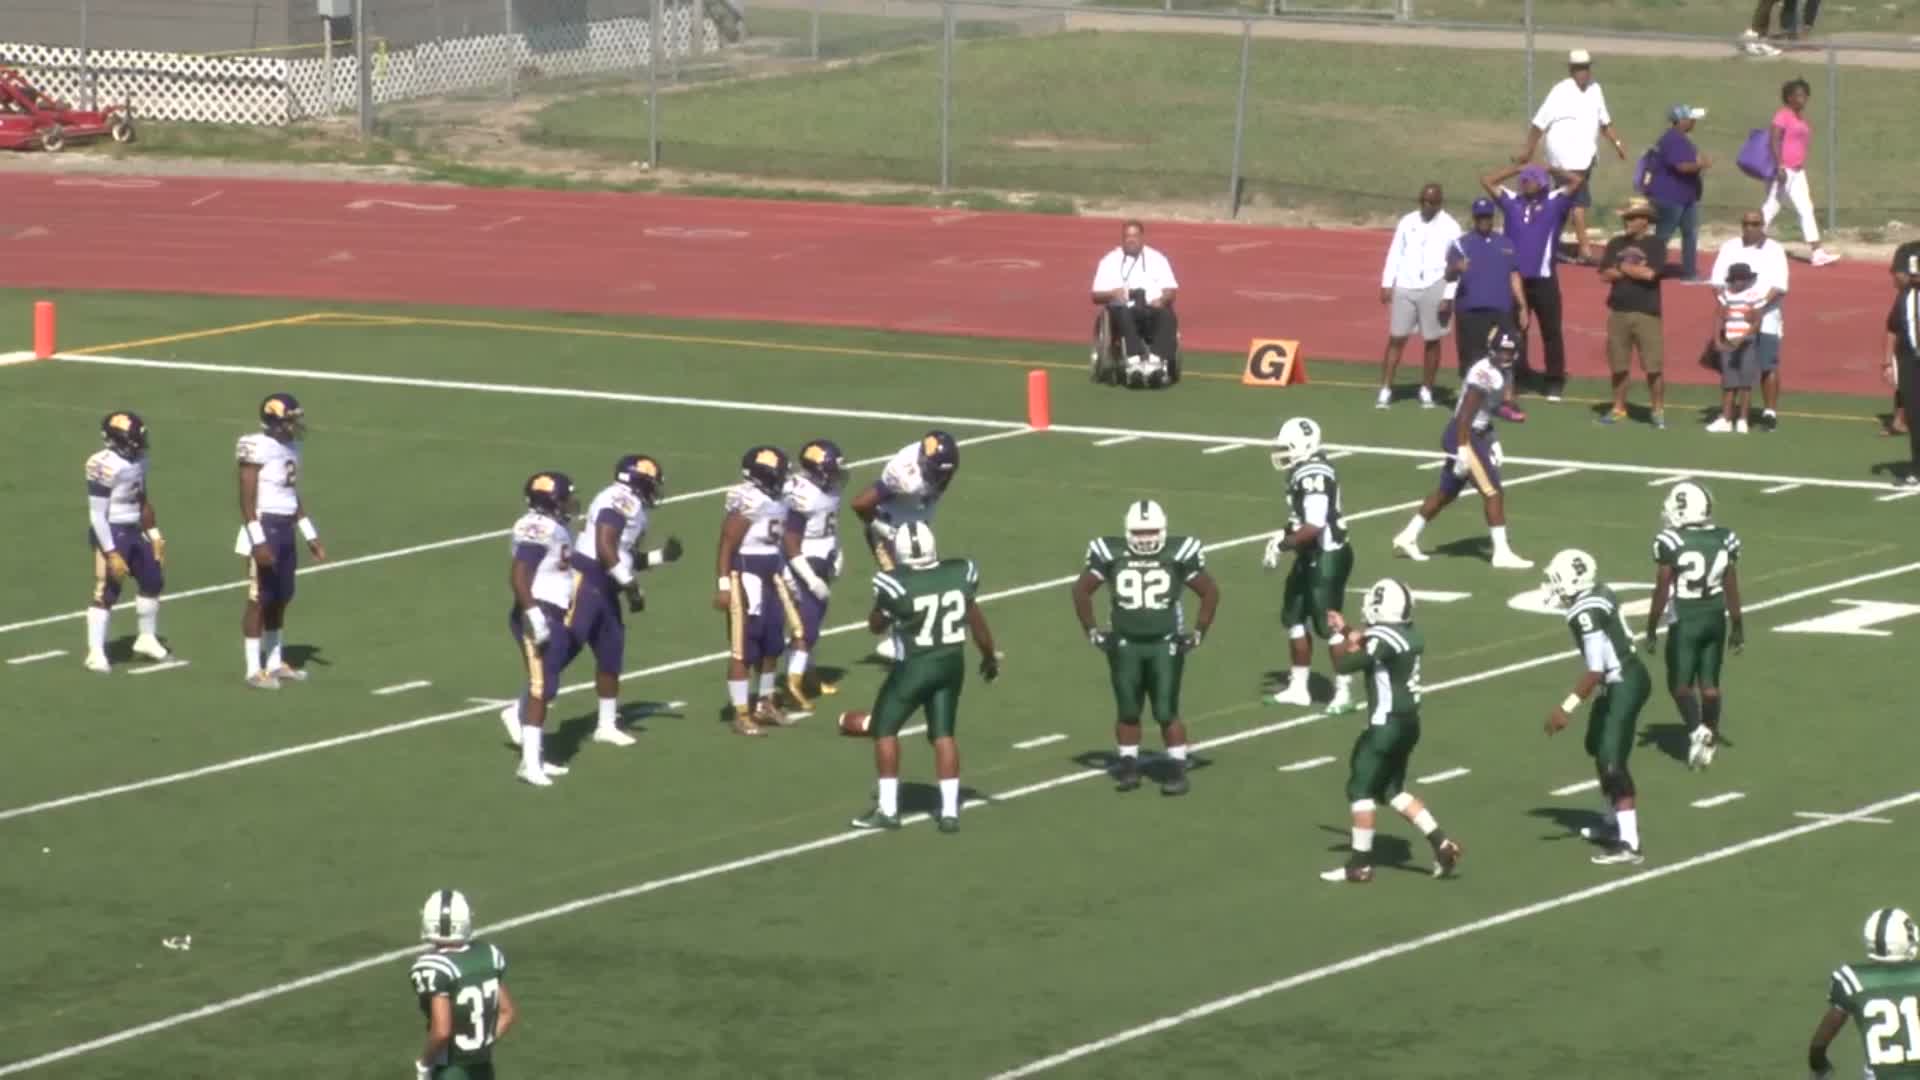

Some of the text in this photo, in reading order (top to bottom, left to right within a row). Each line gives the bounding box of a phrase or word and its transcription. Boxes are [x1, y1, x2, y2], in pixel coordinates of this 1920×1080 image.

[1250, 343, 1287, 381] G
[1675, 491, 1687, 510] S
[1116, 568, 1171, 610] 92
[1371, 586, 1386, 606] S
[913, 589, 968, 647] 72
[1578, 611, 1594, 632] 9
[411, 968, 437, 993] 37
[1863, 996, 1920, 1065] 21
